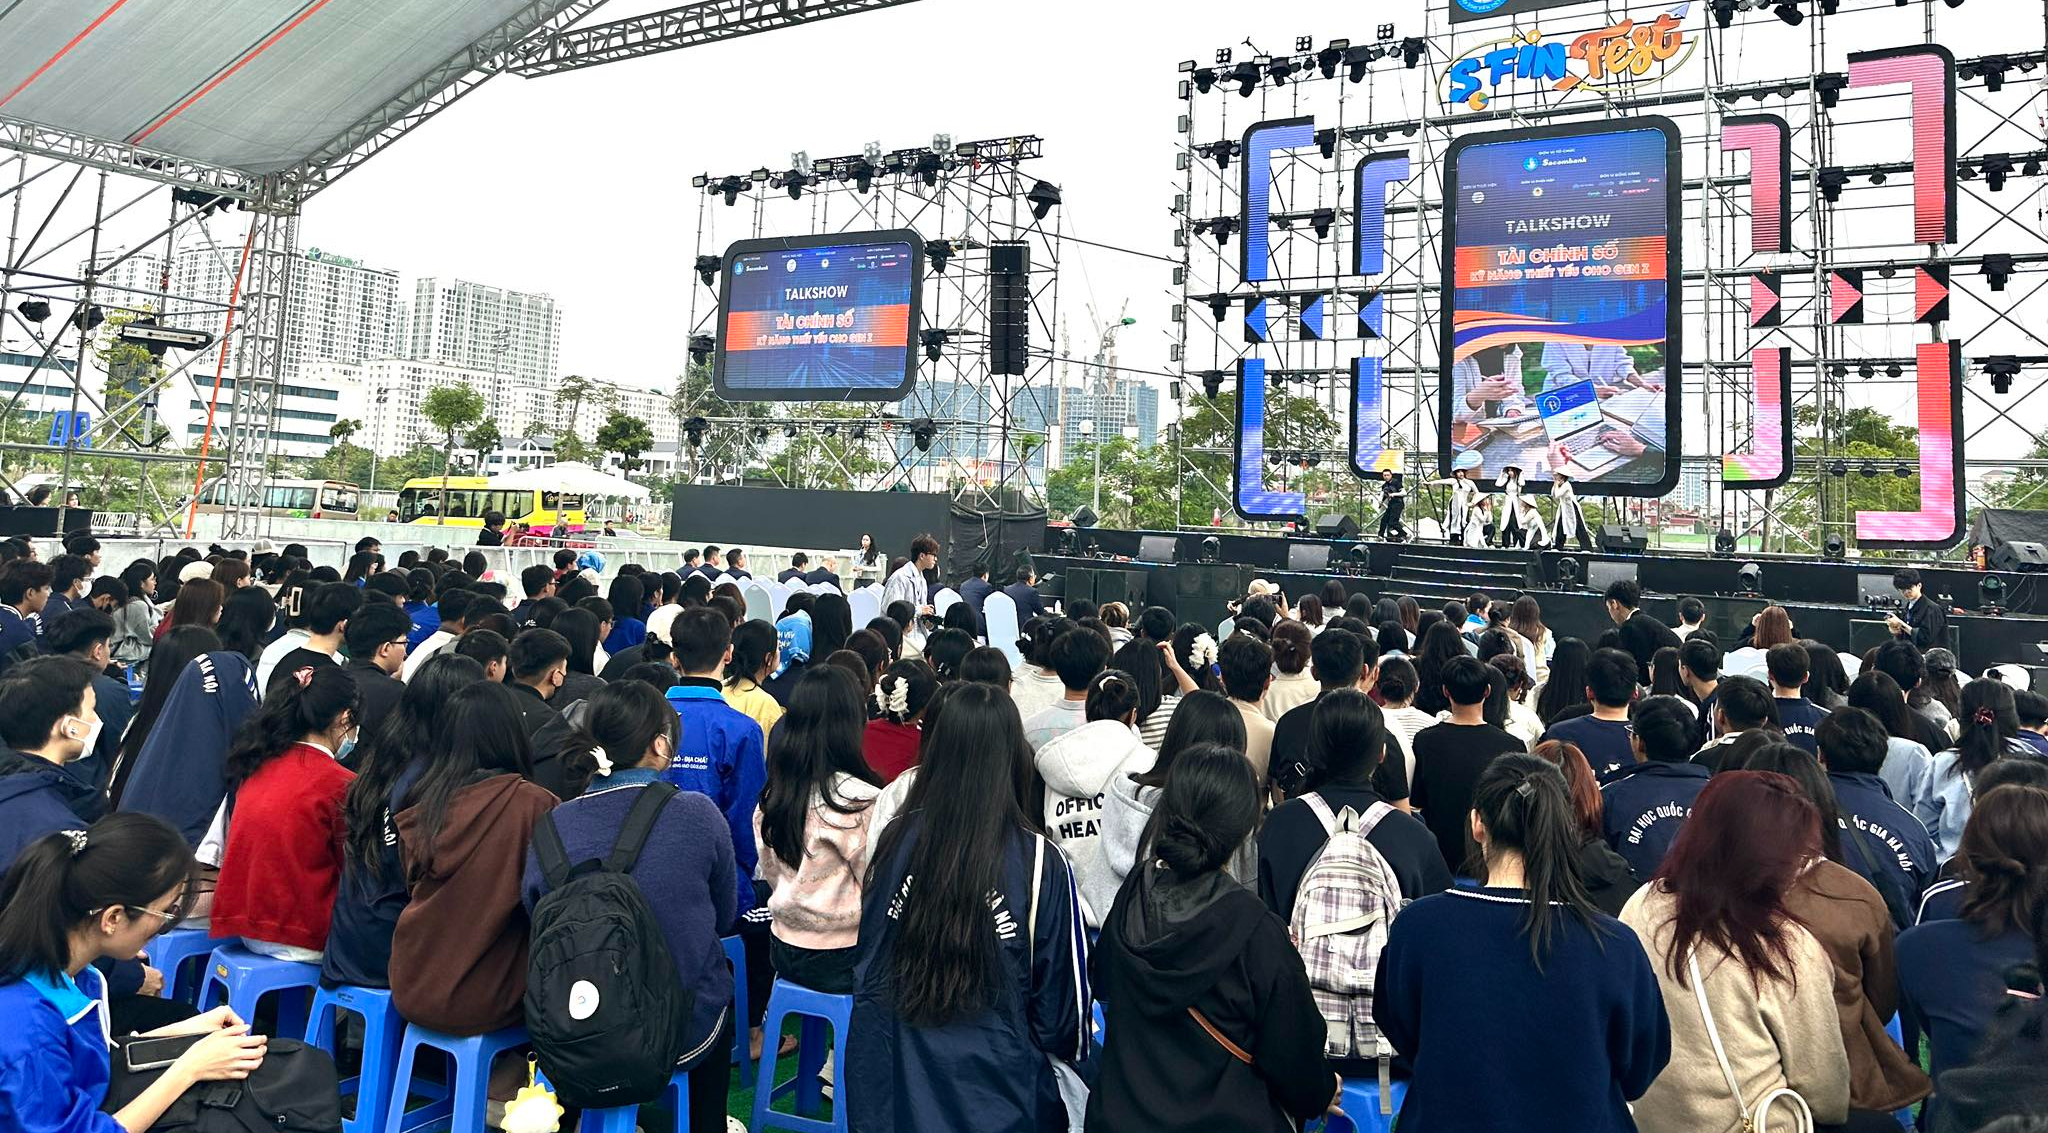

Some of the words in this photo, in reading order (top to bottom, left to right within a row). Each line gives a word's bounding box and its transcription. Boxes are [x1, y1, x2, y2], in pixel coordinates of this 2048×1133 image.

[1570, 14, 1684, 80] Fest
[1542, 156, 1587, 167] Sacombank
[1505, 215, 1611, 234] TALKSHOW
[1498, 247, 1525, 265] TÀI
[1529, 244, 1588, 263] CHÍNH
[1592, 238, 1619, 260] SỐ
[1525, 264, 1555, 278] THIẾT
[1557, 263, 1579, 277] YẾU
[1582, 265, 1611, 276] CHO
[1613, 263, 1639, 275] GEN
[1642, 263, 1650, 274] Z
[785, 285, 848, 300] TALKSHOW
[776, 312, 795, 330] TÀI
[796, 311, 834, 329] CHÍNH
[836, 308, 855, 328] SỐ
[1055, 792, 1104, 817] OFFIC
[1059, 819, 1101, 839] HEA
[1627, 826, 1643, 844] ĐẠI
[1636, 810, 1657, 829] HỌC
[1656, 801, 1683, 818] QUỐC
[1869, 823, 1888, 840] GIA
[993, 909, 1018, 939] NỘI
